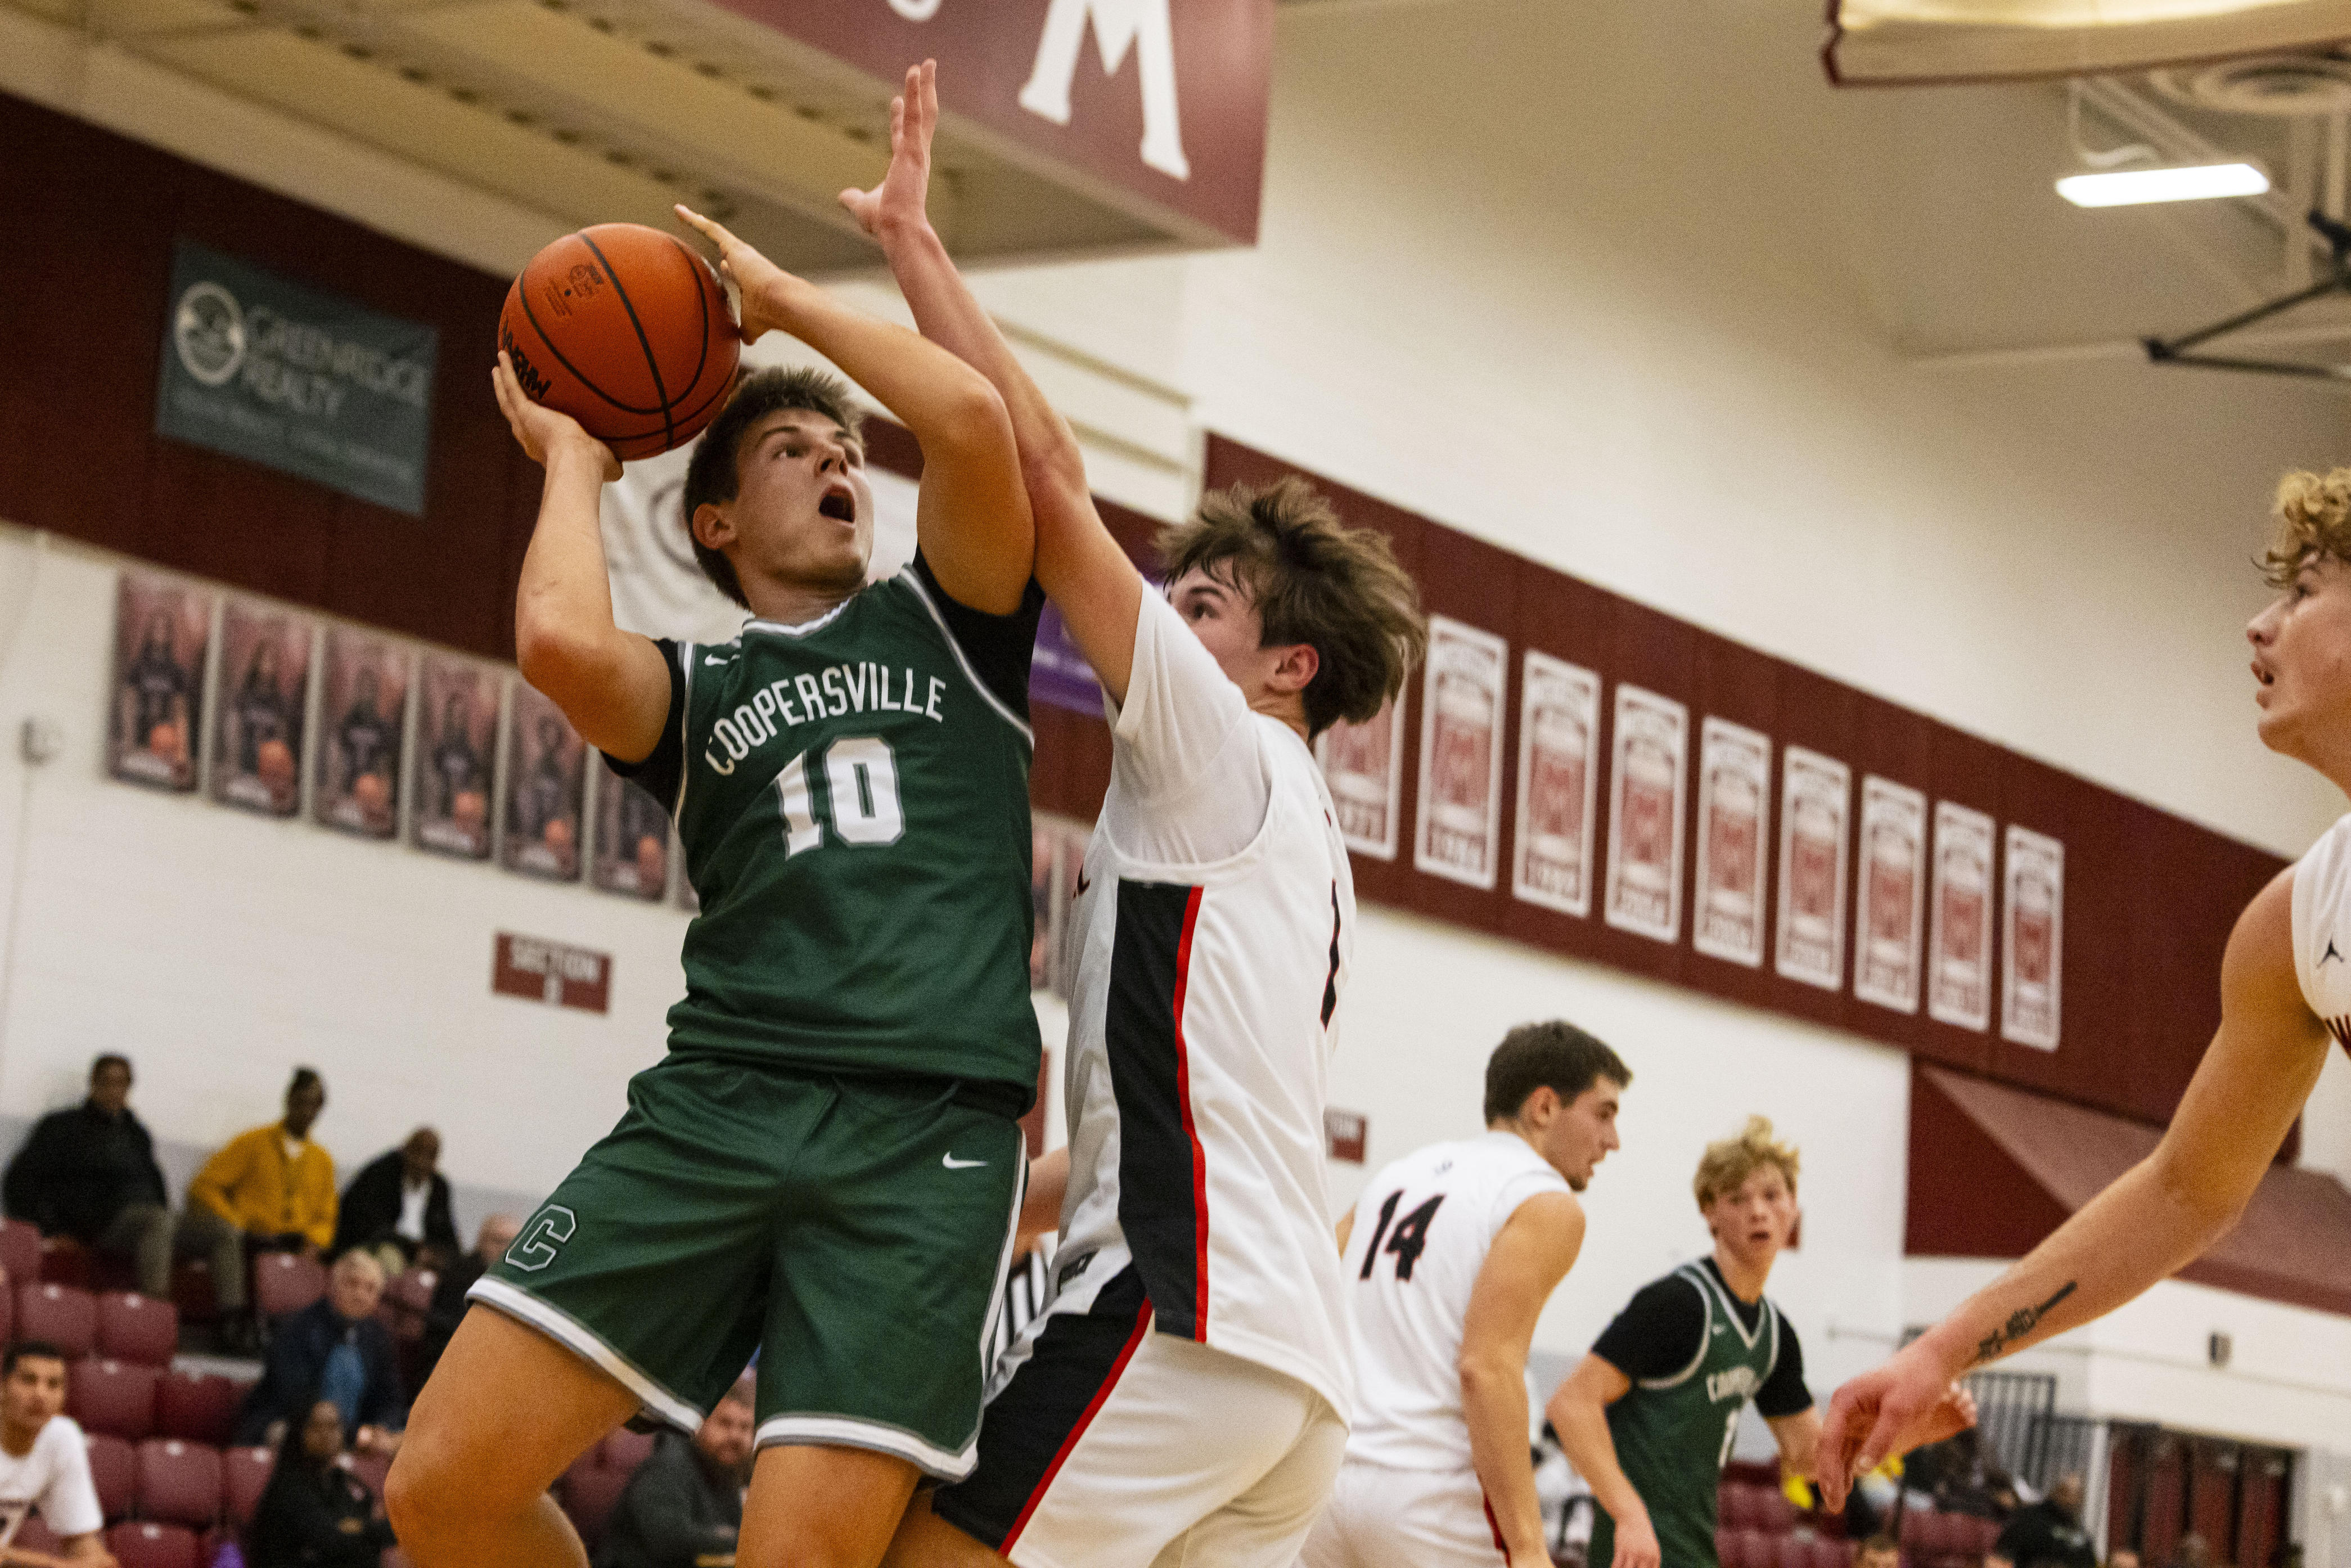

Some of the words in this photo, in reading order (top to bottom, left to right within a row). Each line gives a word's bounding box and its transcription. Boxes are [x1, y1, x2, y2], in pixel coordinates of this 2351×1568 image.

[705, 661, 947, 776] COOPERSVILLE
[769, 735, 906, 860] 10
[505, 1203, 577, 1272] C
[1359, 1188, 1447, 1283] 14
